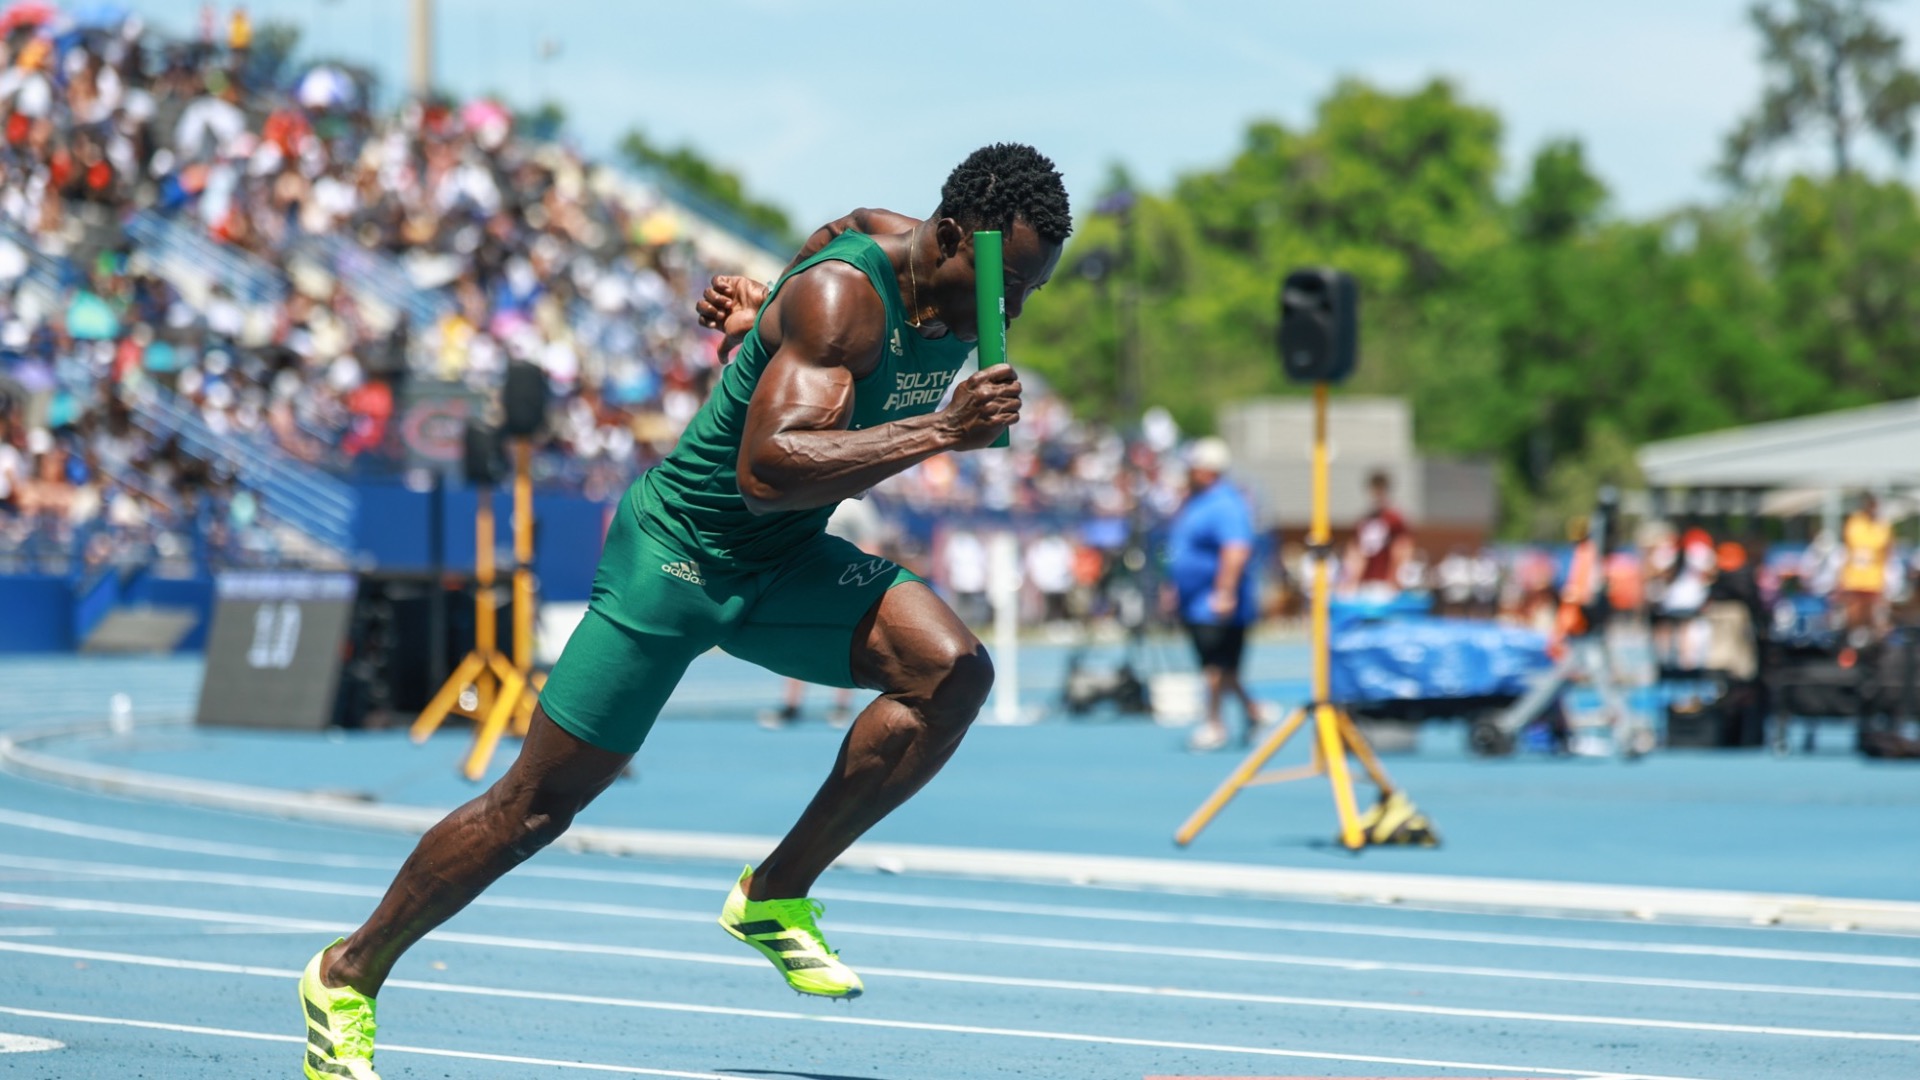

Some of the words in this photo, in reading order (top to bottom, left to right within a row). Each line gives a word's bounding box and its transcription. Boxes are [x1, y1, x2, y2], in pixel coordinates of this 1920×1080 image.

[896, 369, 956, 391] SOUTH
[882, 388, 946, 411] FLORID
[661, 563, 706, 586] adidas
